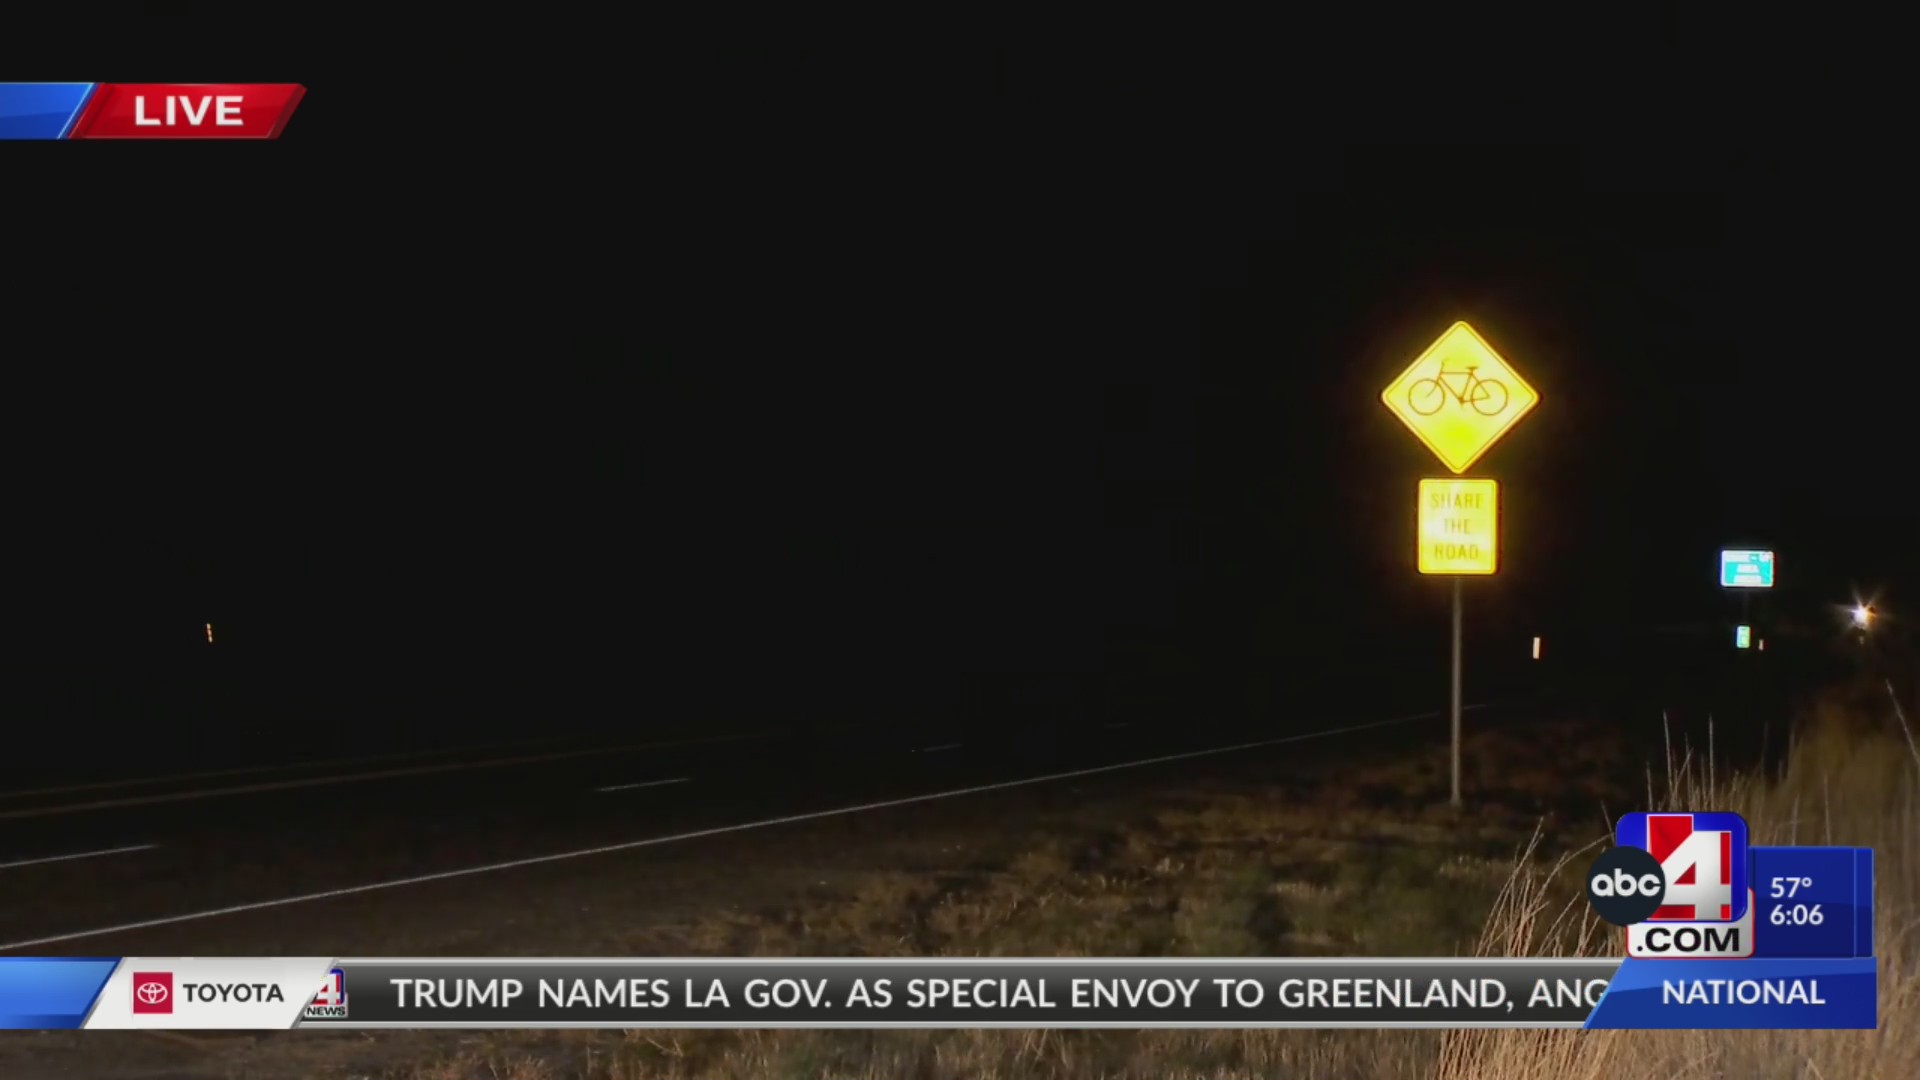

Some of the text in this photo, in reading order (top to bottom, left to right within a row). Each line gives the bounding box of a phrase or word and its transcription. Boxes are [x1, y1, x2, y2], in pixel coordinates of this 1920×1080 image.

[1430, 493, 1484, 509] SHARE
[1443, 518, 1471, 534] THE
[1433, 544, 1480, 560] ROAD
